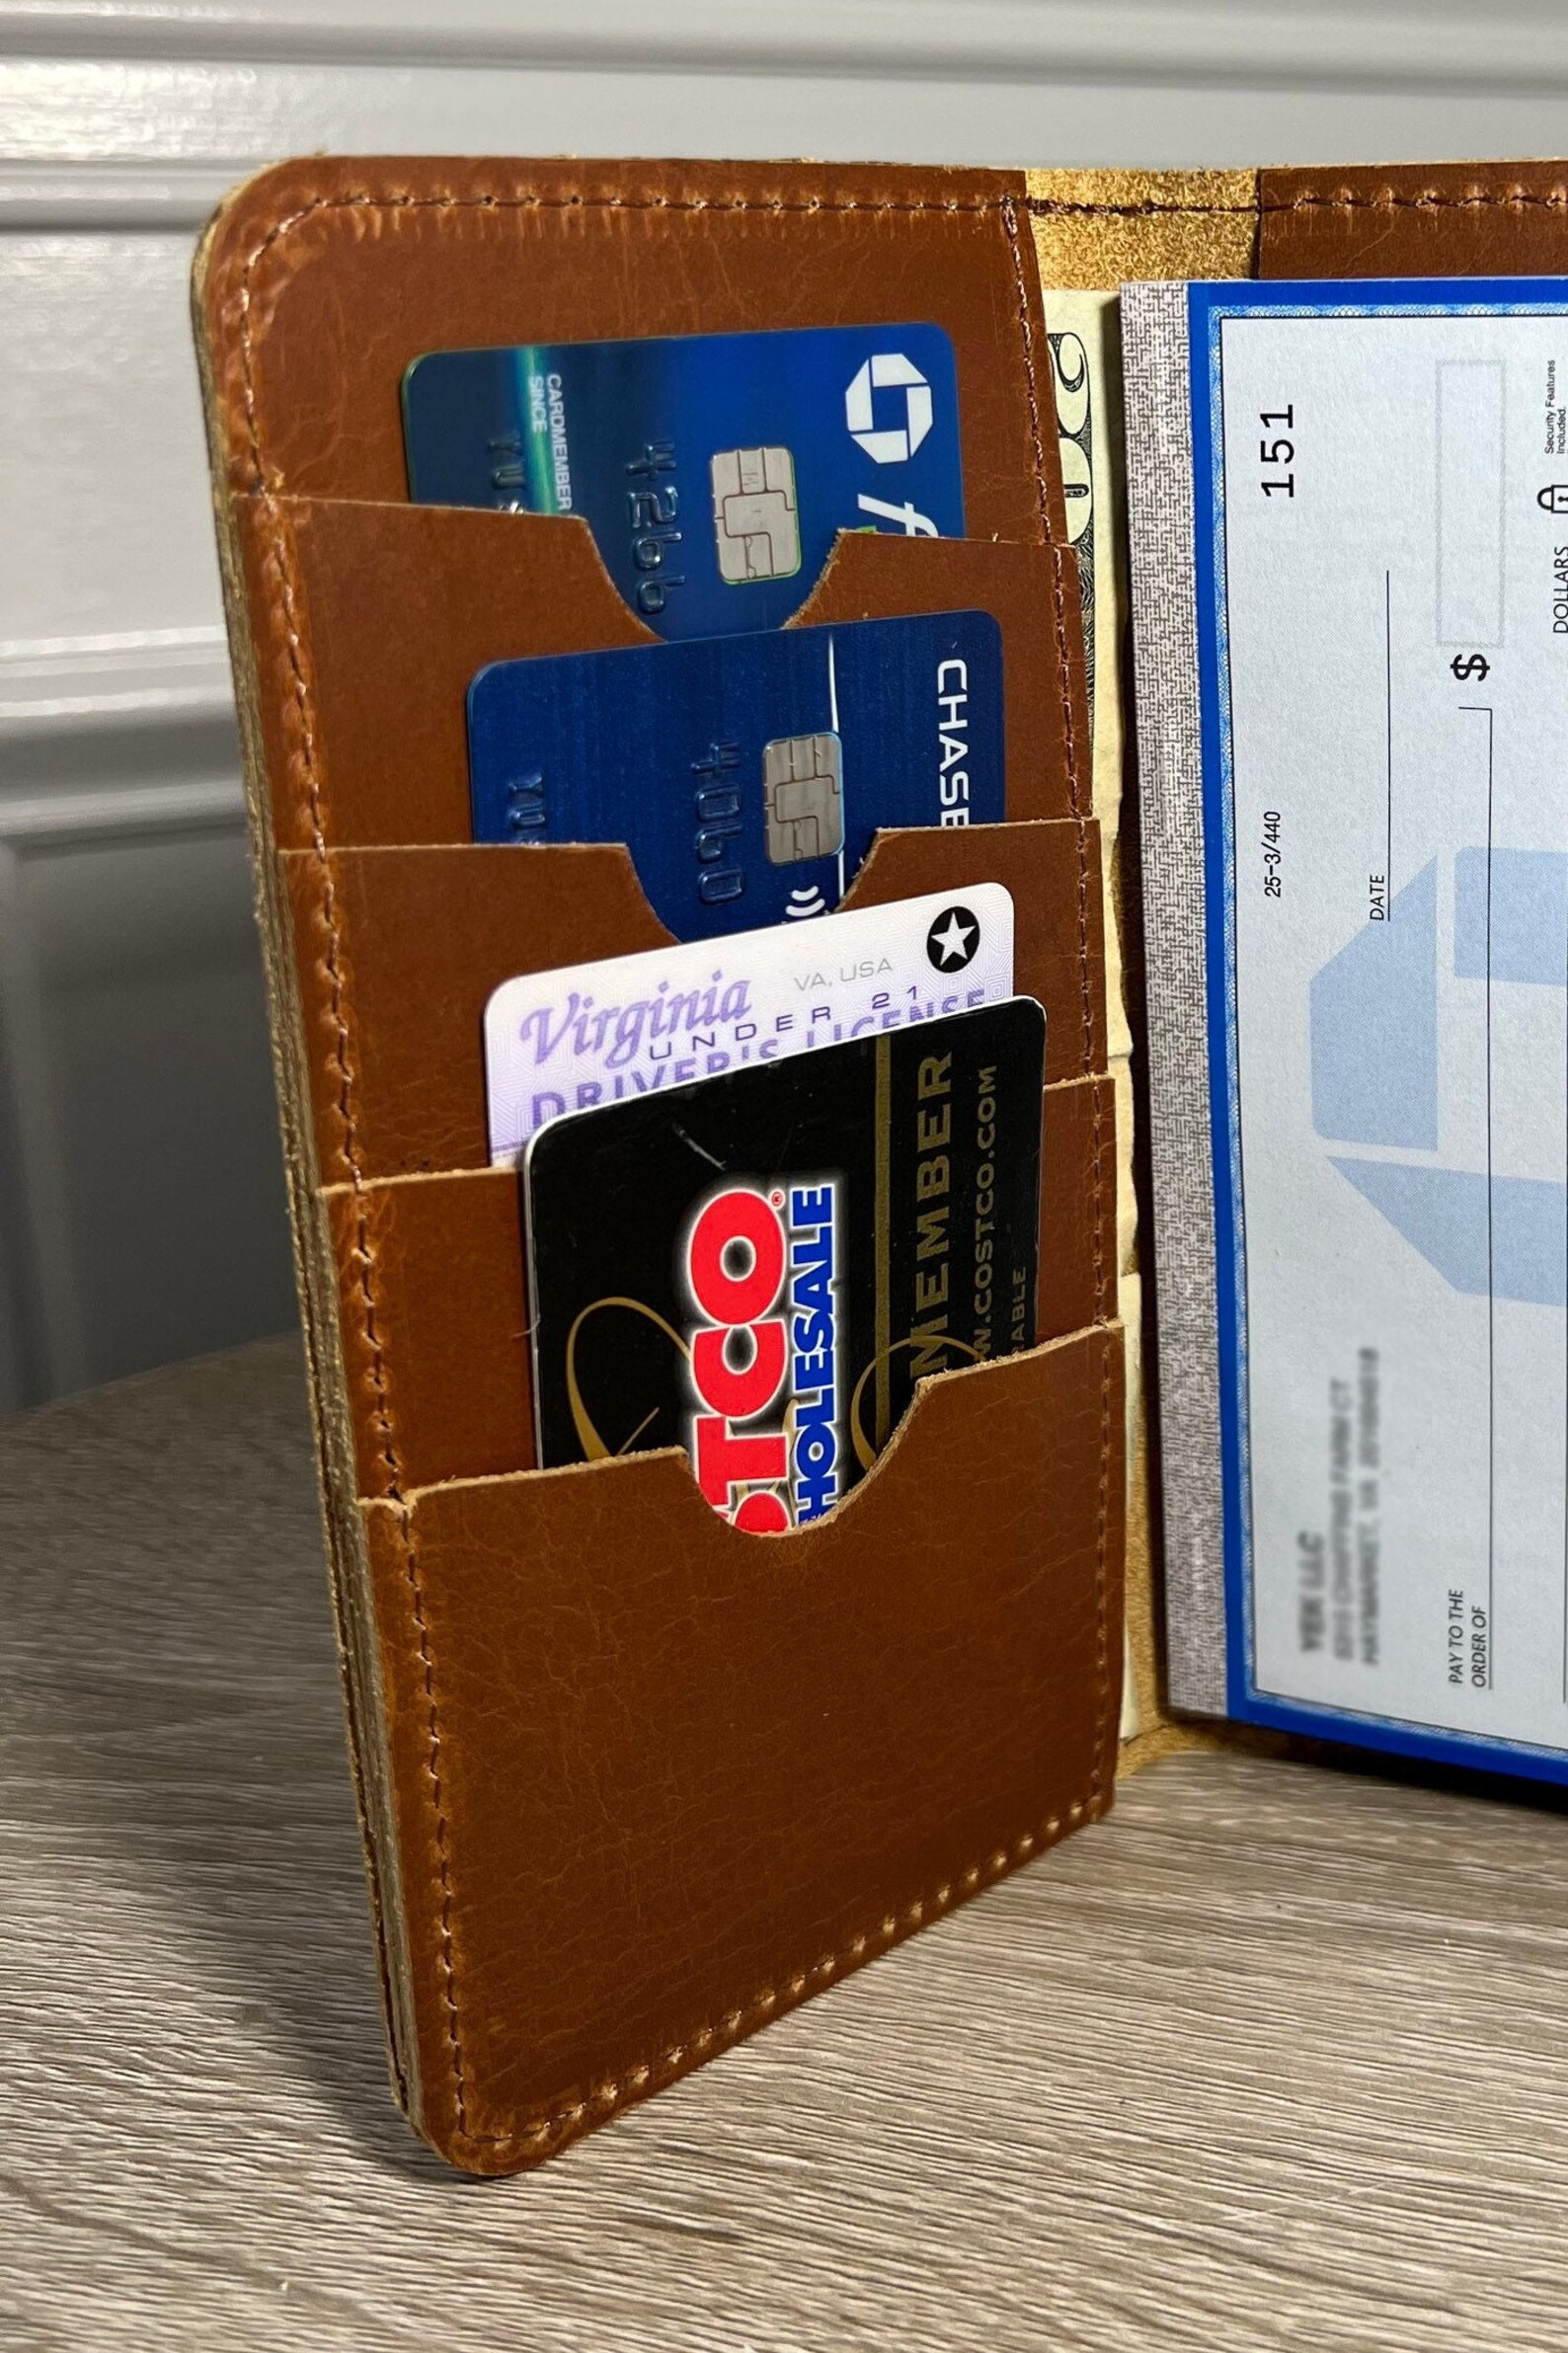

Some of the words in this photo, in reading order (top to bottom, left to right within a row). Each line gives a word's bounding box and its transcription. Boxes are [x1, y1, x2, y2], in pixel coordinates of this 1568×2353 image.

[528, 375, 547, 432] SINCE
[1544, 359, 1555, 408] Features
[547, 373, 572, 510] CARDMEMBER
[1260, 403, 1295, 499] 151
[1544, 411, 1556, 454] Security
[625, 439, 685, 614] 4266
[1552, 545, 1568, 634] DOLLARS
[1450, 653, 1491, 681] $
[937, 660, 971, 826] CHASE
[691, 741, 745, 904] 4060
[1260, 811, 1282, 898] 25-3/440
[1370, 874, 1384, 921] DATE
[839, 958, 893, 982] USA
[520, 970, 752, 1070] Virginia
[649, 1005, 831, 1061] UNDER
[870, 985, 918, 1009] 21
[910, 1050, 954, 1378] MEMBER
[1448, 1589, 1463, 1620] THE
[1471, 1605, 1486, 1629] OF
[1448, 1625, 1463, 1648] TO
[1471, 1633, 1486, 1687] ORDER
[1448, 1652, 1463, 1685] PAY
